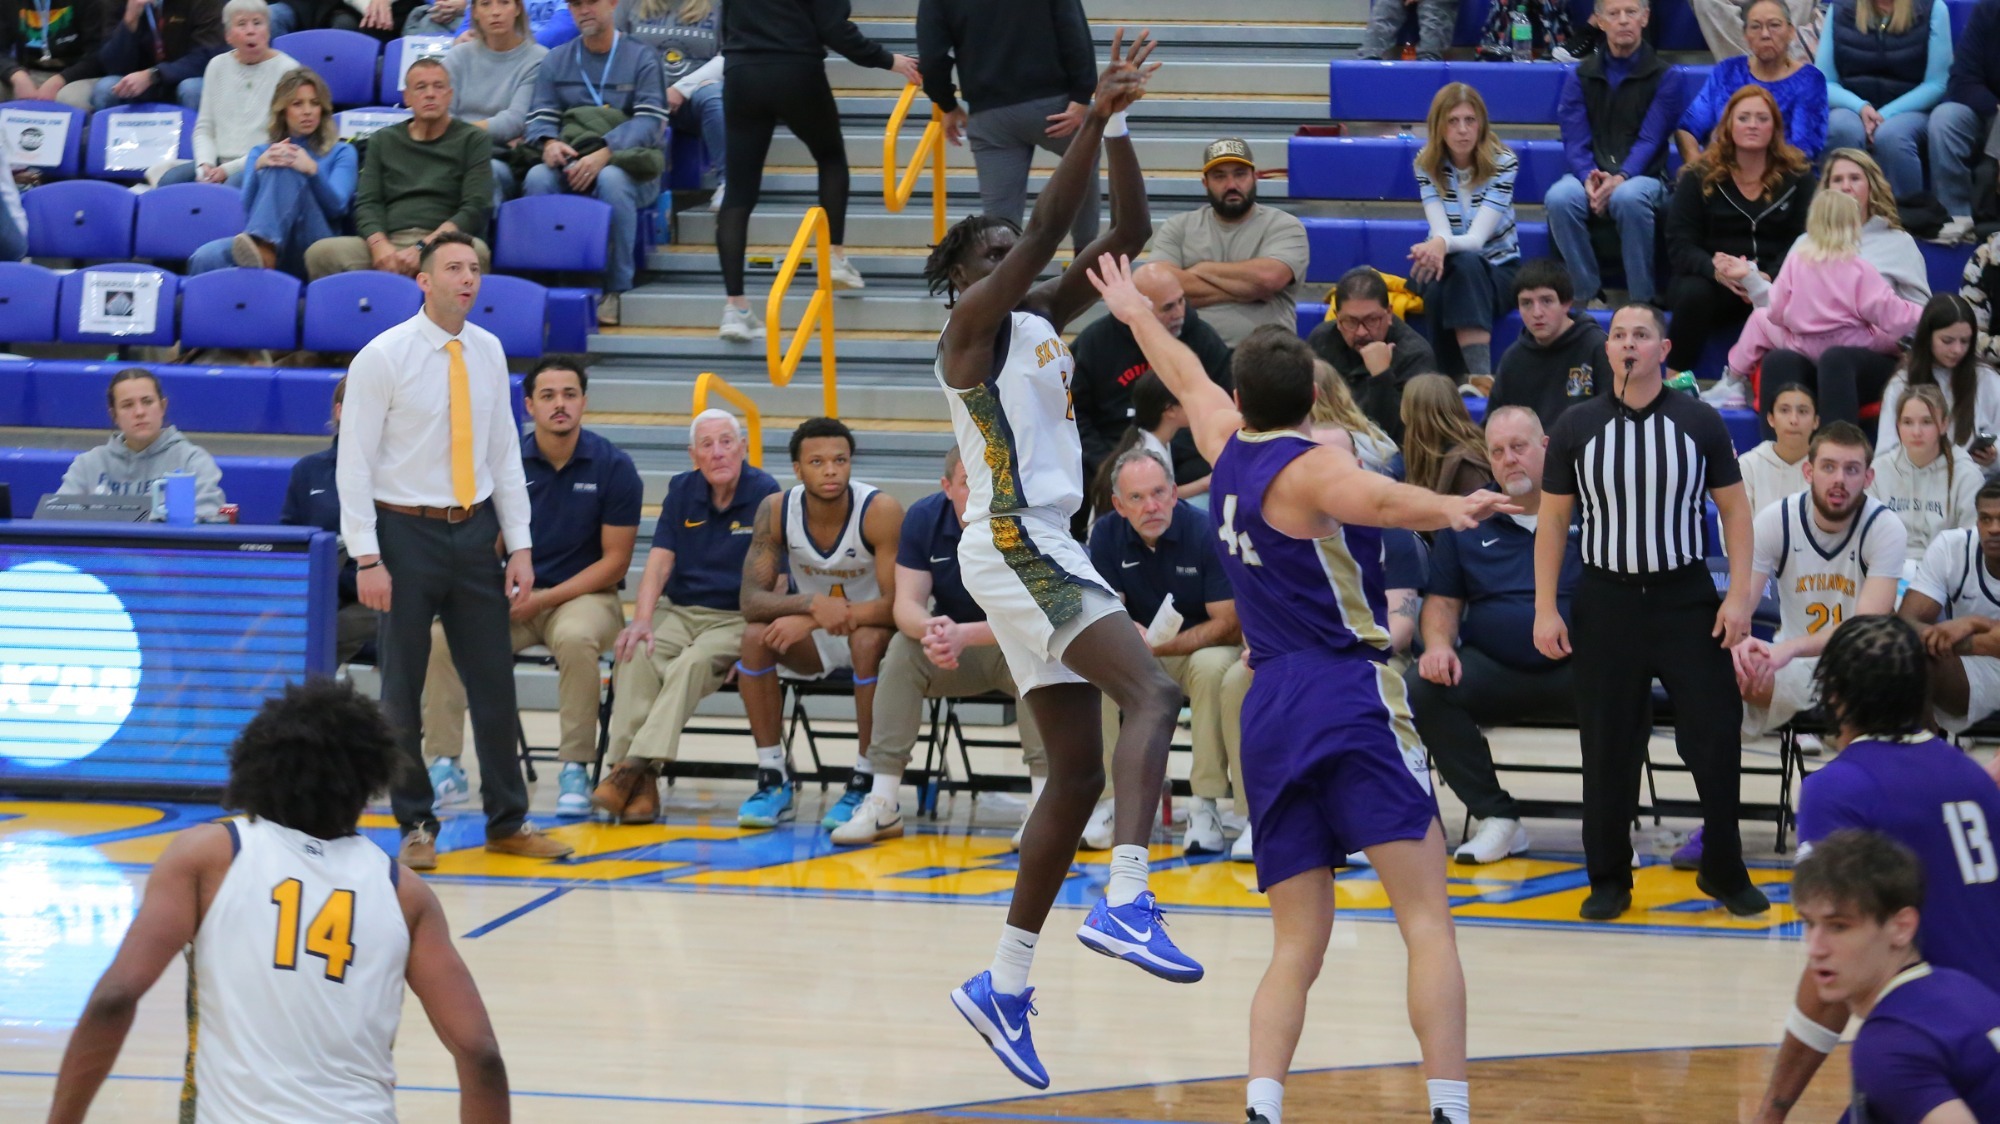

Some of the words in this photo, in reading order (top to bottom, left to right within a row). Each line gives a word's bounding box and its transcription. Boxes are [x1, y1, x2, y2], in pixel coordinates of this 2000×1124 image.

[1806, 602, 1842, 636] 21
[1941, 800, 1999, 885] 13
[271, 877, 356, 984] 14
